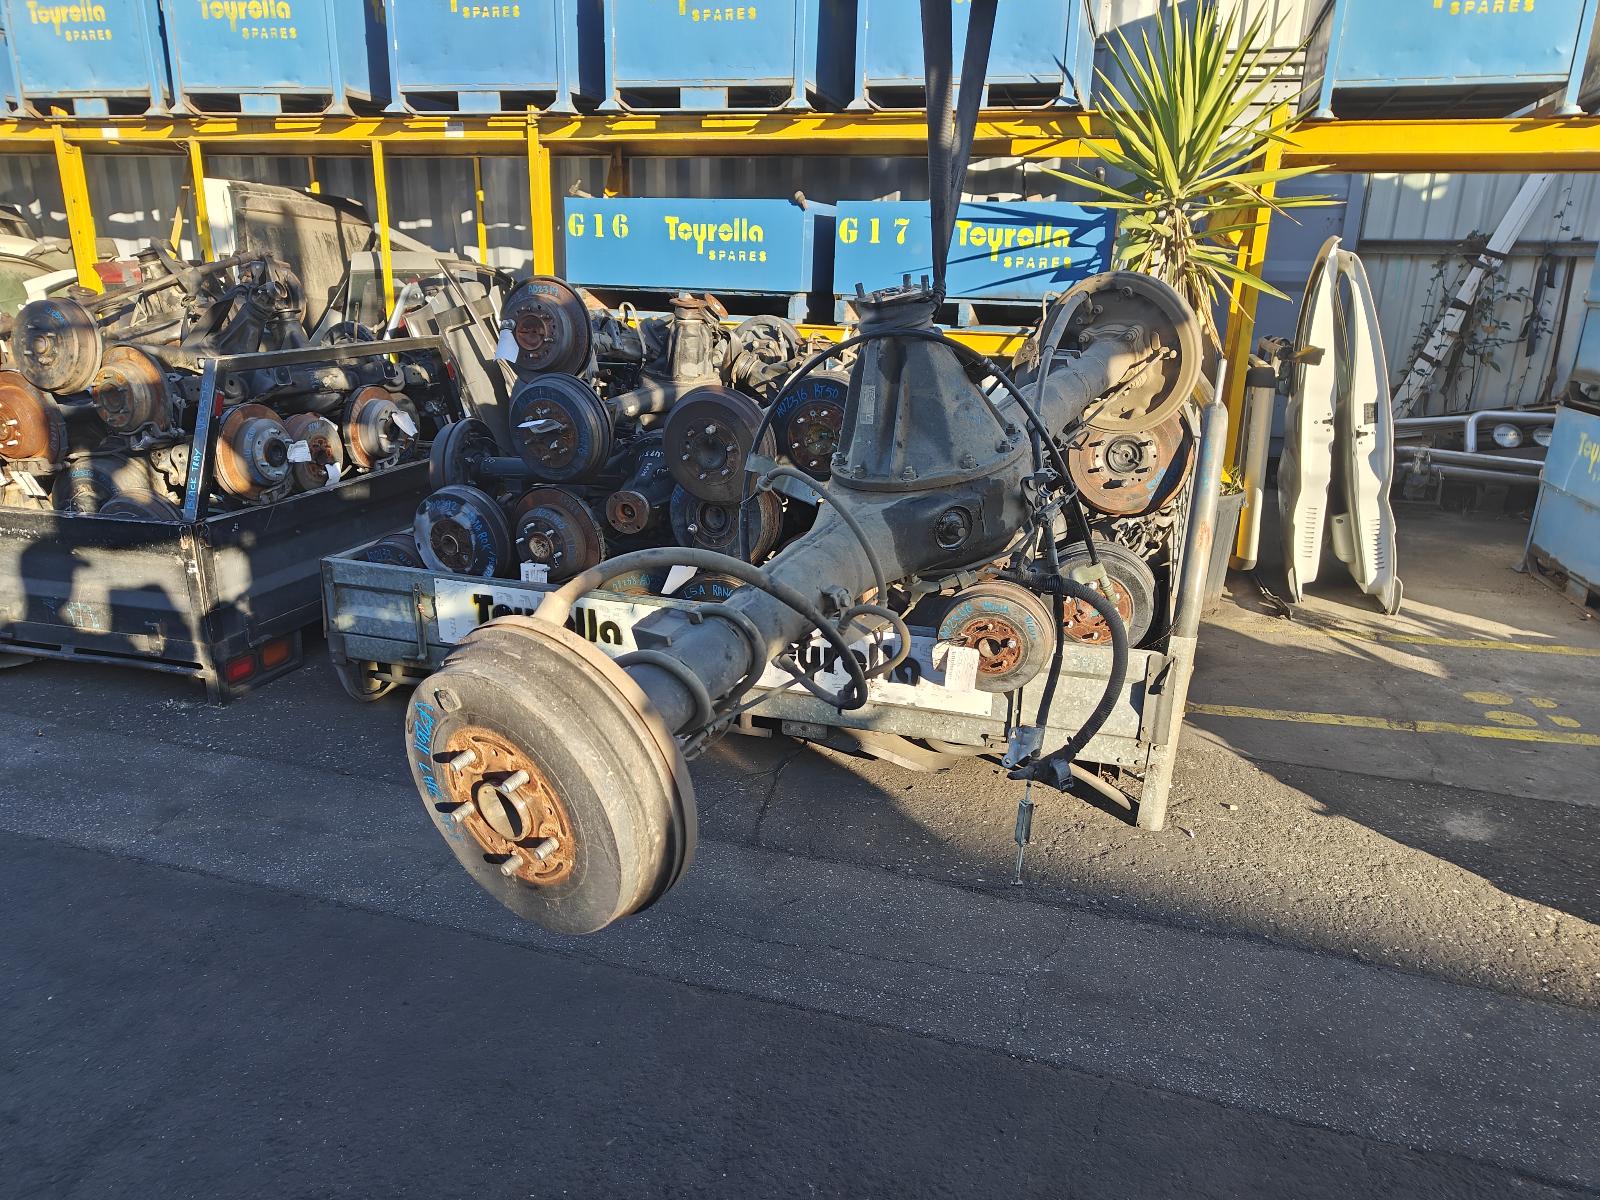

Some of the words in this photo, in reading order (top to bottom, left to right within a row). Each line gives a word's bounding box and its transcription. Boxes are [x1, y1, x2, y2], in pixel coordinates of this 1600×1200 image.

[463, 5, 520, 18] SPARES
[692, 6, 757, 22] SPARES
[1450, 0, 1535, 15] SPARES
[65, 29, 112, 41] SPARES
[242, 27, 297, 39] SPARES
[664, 215, 764, 255] Toyrolla
[956, 219, 1071, 262] Toyrolla
[708, 250, 767, 262] SPARES
[1003, 256, 1072, 269] SPARES
[192, 447, 202, 472] TRAY
